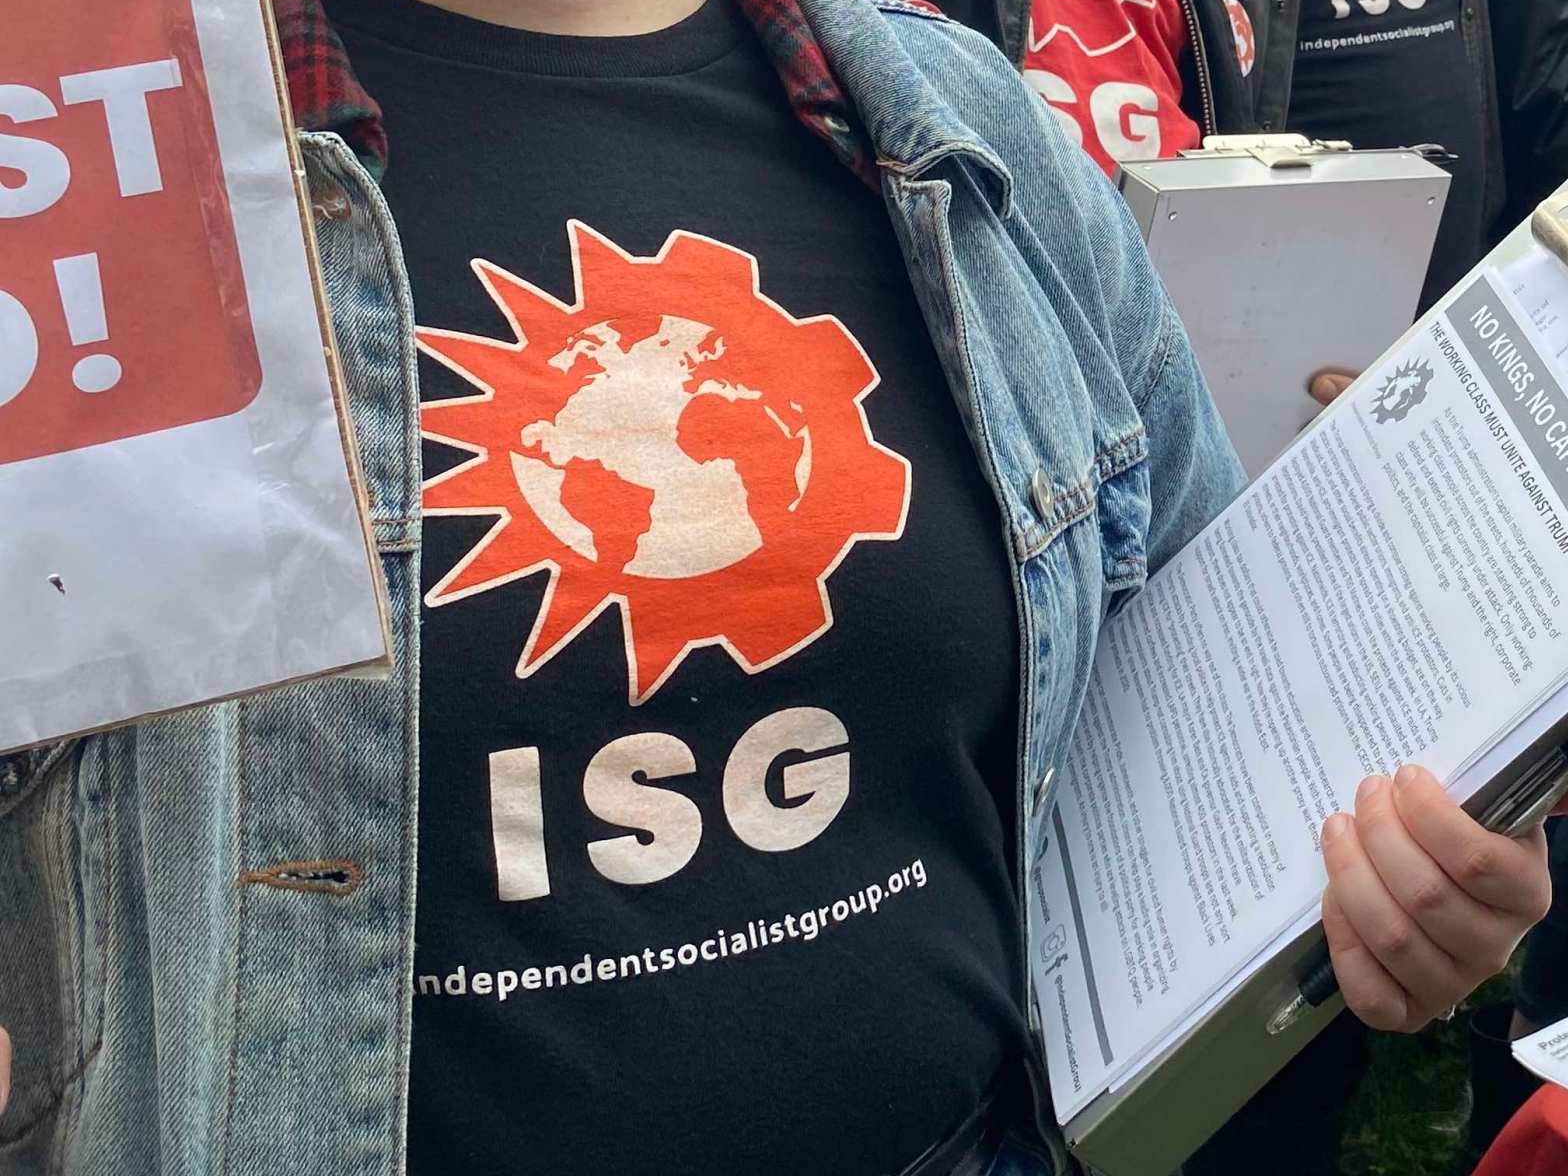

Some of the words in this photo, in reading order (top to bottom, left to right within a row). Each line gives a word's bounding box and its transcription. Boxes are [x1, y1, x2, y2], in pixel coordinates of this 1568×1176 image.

[1024, 69, 1161, 162] SG
[1469, 302, 1501, 342] NO
[1483, 330, 1539, 403] KINGS,
[1428, 319, 1446, 342] THE
[1437, 335, 1472, 386] WORKING
[1463, 379, 1491, 417] CLASS
[1481, 409, 1508, 445] MUST
[1499, 438, 1526, 476] UNITE
[1516, 467, 1553, 520] AGAINST
[1524, 388, 1558, 429] NO
[489, 706, 851, 902] ISG
